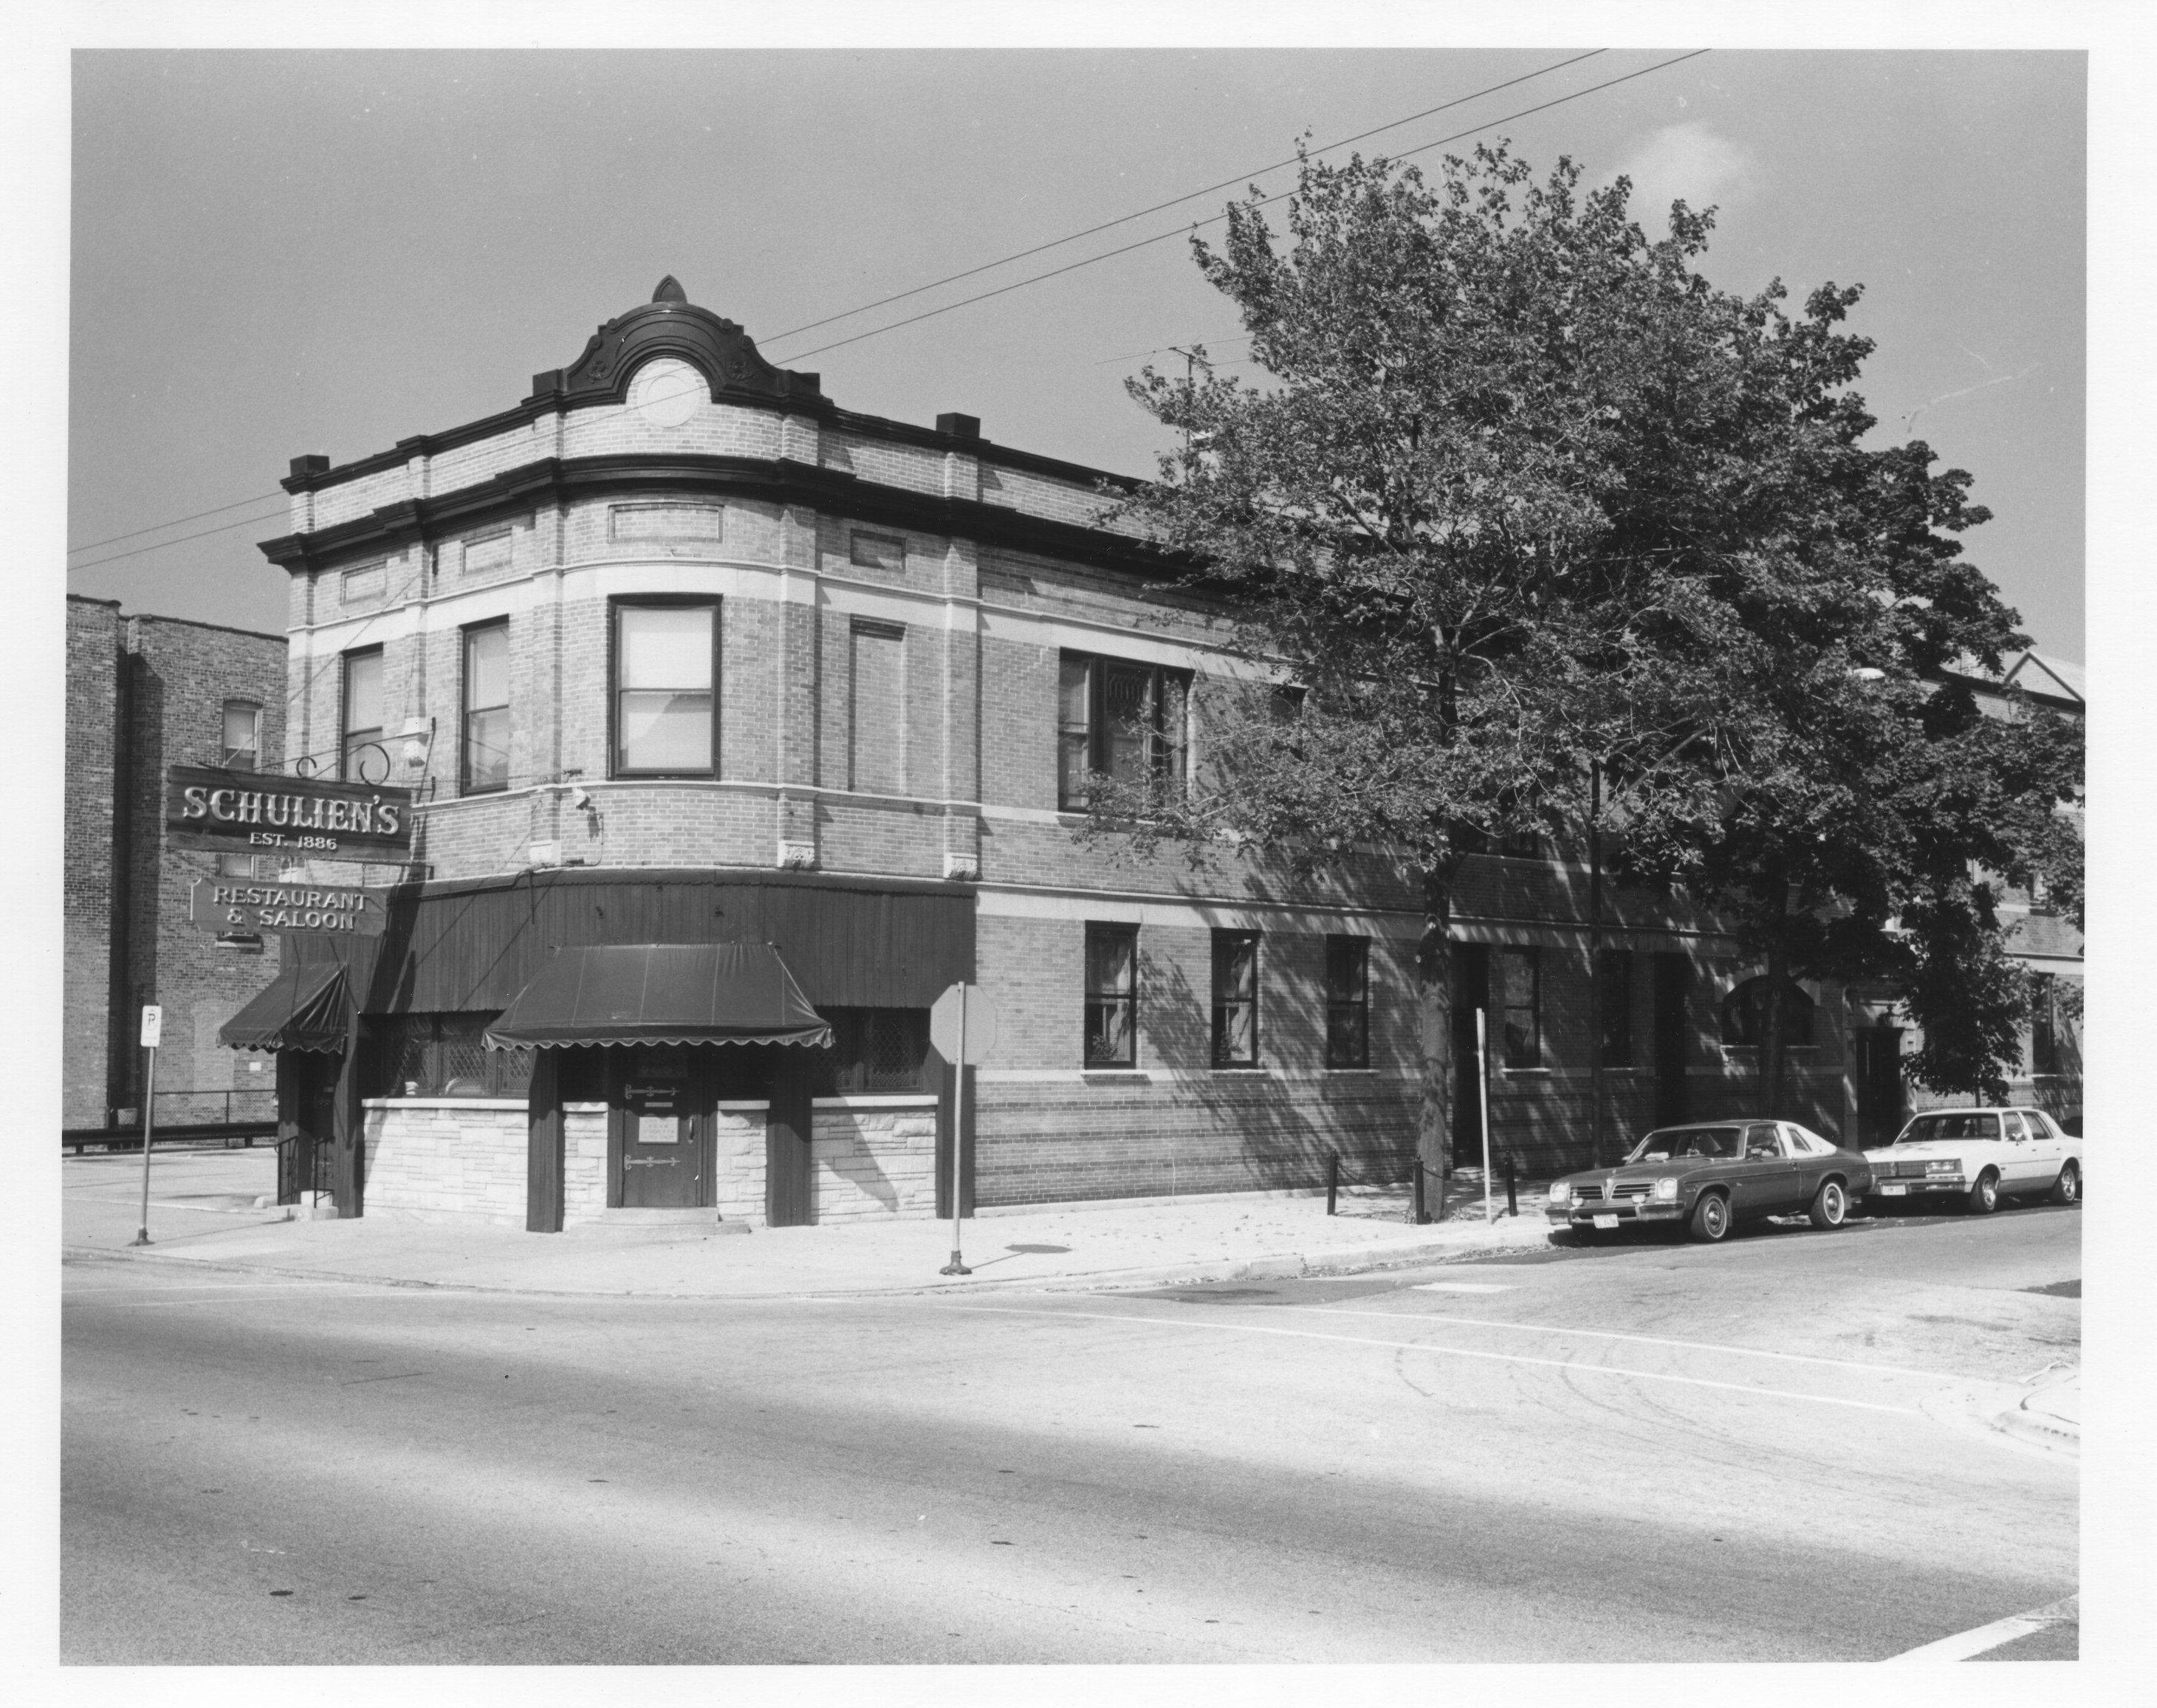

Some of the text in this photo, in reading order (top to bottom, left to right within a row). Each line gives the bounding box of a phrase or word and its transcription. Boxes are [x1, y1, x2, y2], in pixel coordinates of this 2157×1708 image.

[182, 786, 399, 834] SCHULIEN'S
[250, 832, 337, 850] EST. 1886
[214, 885, 368, 910] RESTAURANT
[227, 908, 355, 930] & SALOON
